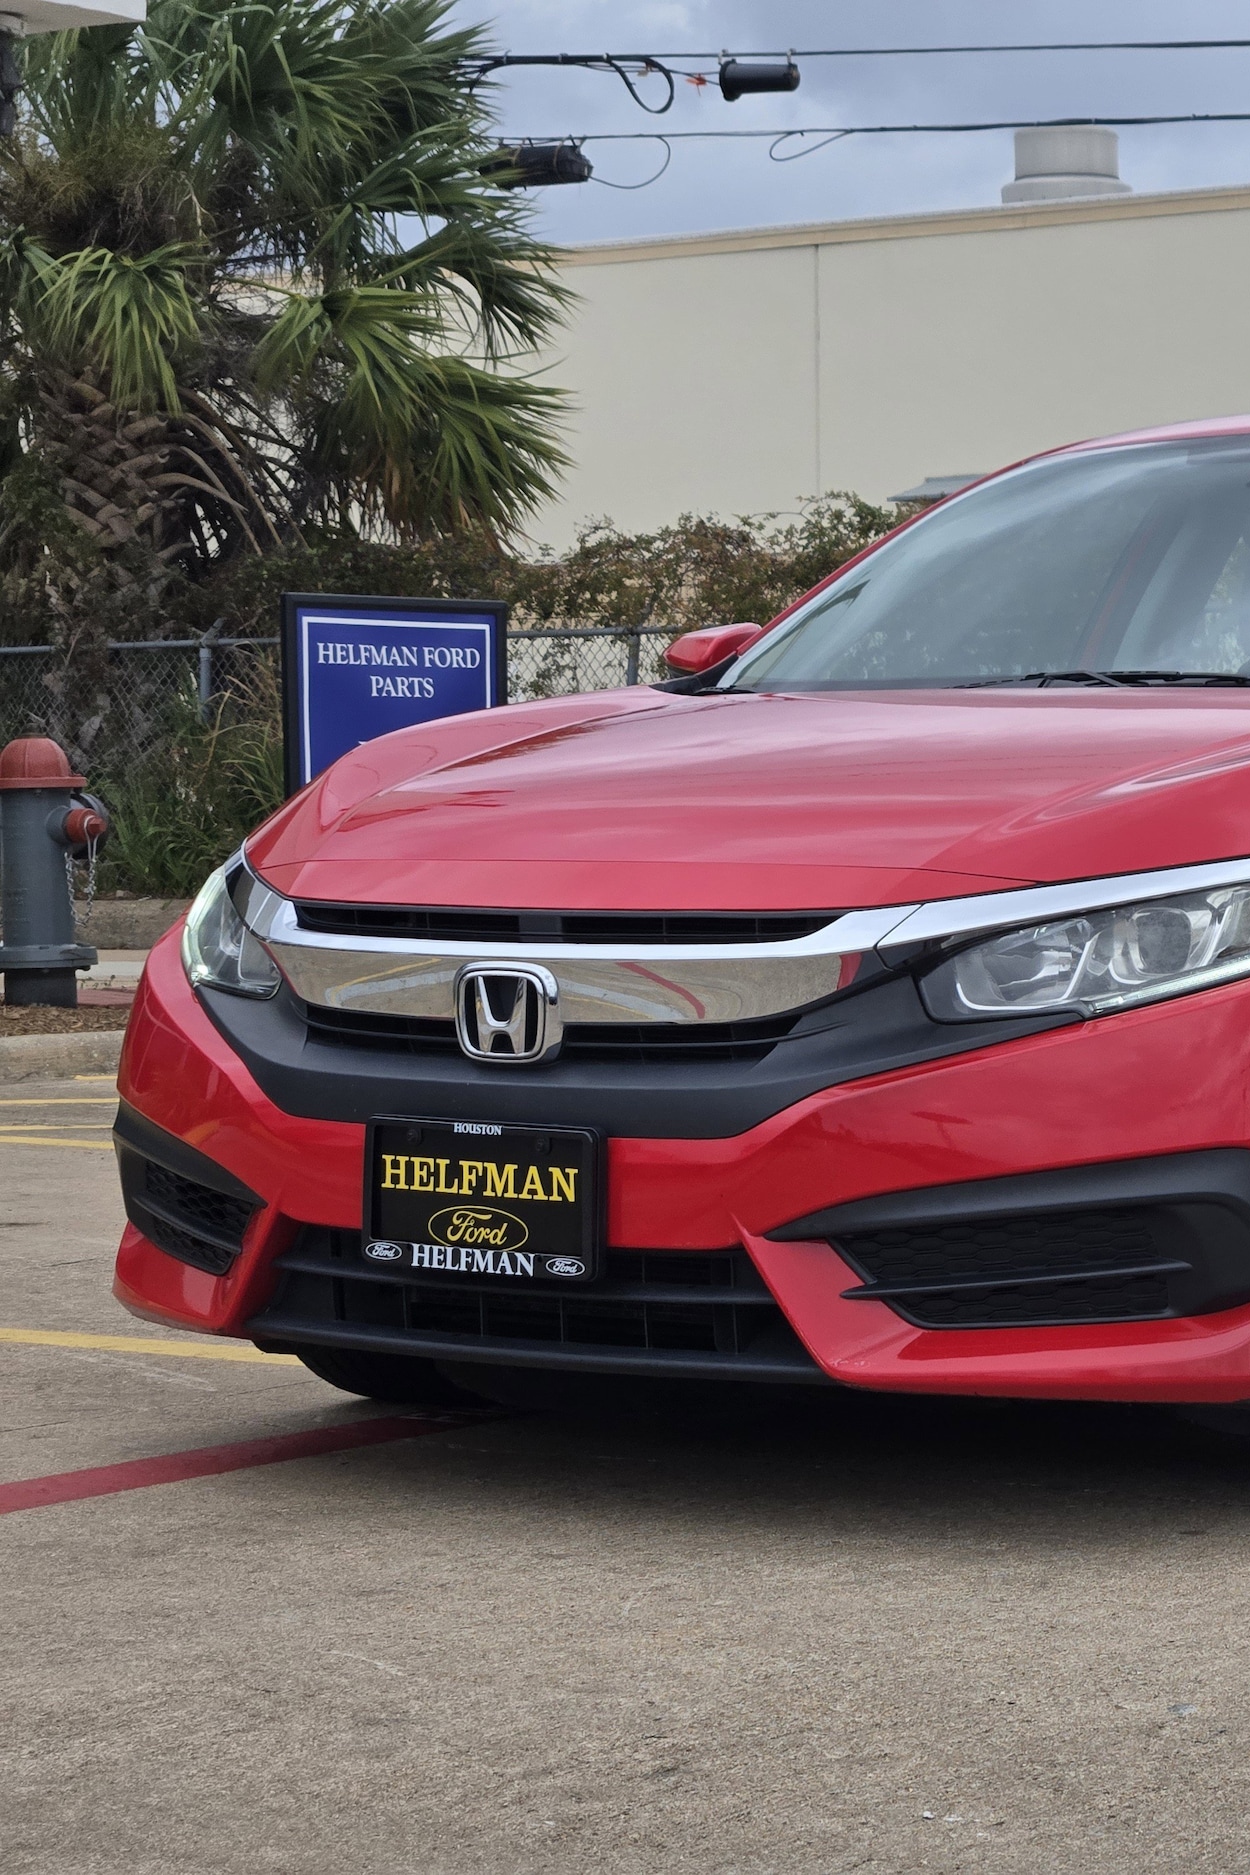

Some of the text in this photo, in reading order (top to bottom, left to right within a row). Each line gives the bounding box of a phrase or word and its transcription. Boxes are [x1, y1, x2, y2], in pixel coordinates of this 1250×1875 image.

[317, 642, 481, 669] HELFMAN FORD
[370, 675, 435, 699] PARTS
[453, 1122, 503, 1136] HOUSTON
[381, 1154, 579, 1203] HELFMAN
[446, 1210, 509, 1246] Ford
[372, 1244, 396, 1258] Ford
[411, 1242, 536, 1277] HELFMAN
[552, 1260, 579, 1274] Ford
